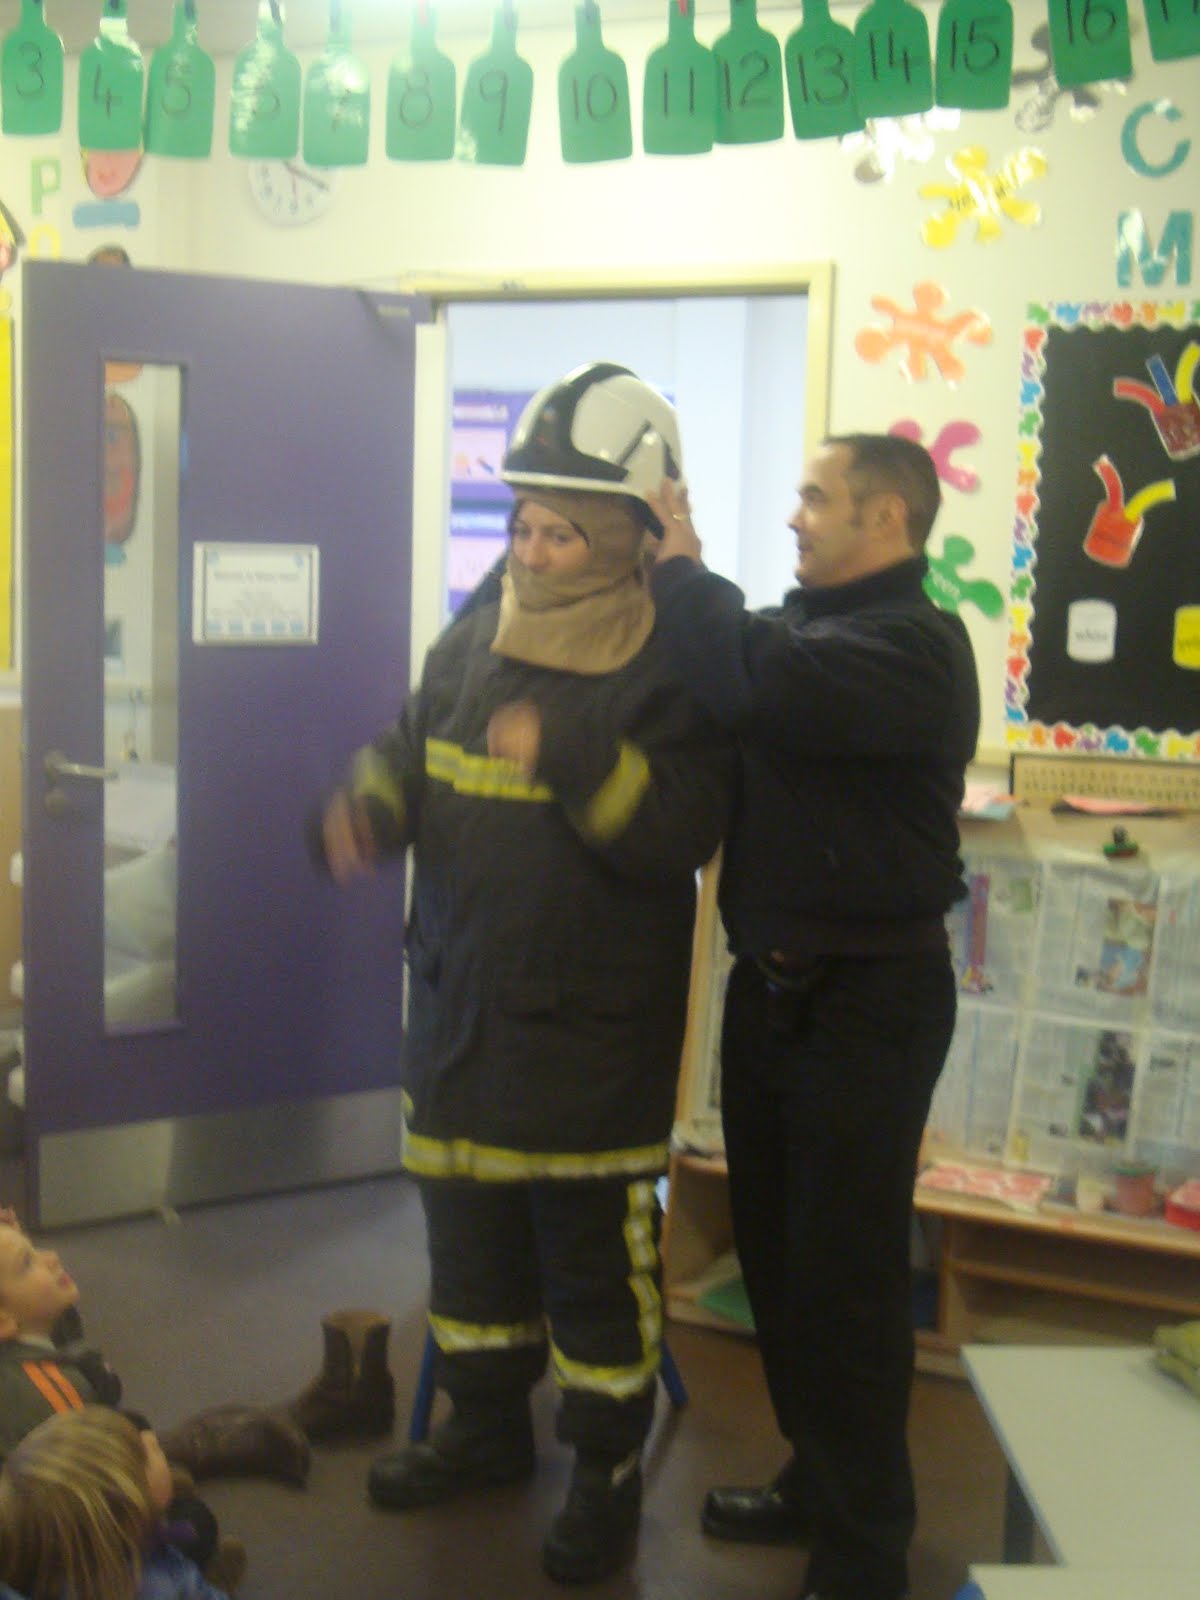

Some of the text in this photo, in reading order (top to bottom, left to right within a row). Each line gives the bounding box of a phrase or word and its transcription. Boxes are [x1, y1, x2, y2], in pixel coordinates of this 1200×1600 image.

[951, 16, 1001, 74] 15
[1064, 0, 1117, 45] 16
[14, 40, 45, 98] 3
[722, 50, 774, 112] 12
[798, 45, 850, 106] 13
[868, 27, 924, 84] 14
[92, 62, 122, 119] 4
[160, 60, 193, 118] 5
[399, 66, 433, 129] 8
[478, 69, 510, 133] 9
[572, 71, 618, 123] 10
[662, 65, 696, 118] 11
[1120, 99, 1192, 179] C
[30, 157, 62, 216] P
[1115, 207, 1193, 289] M
